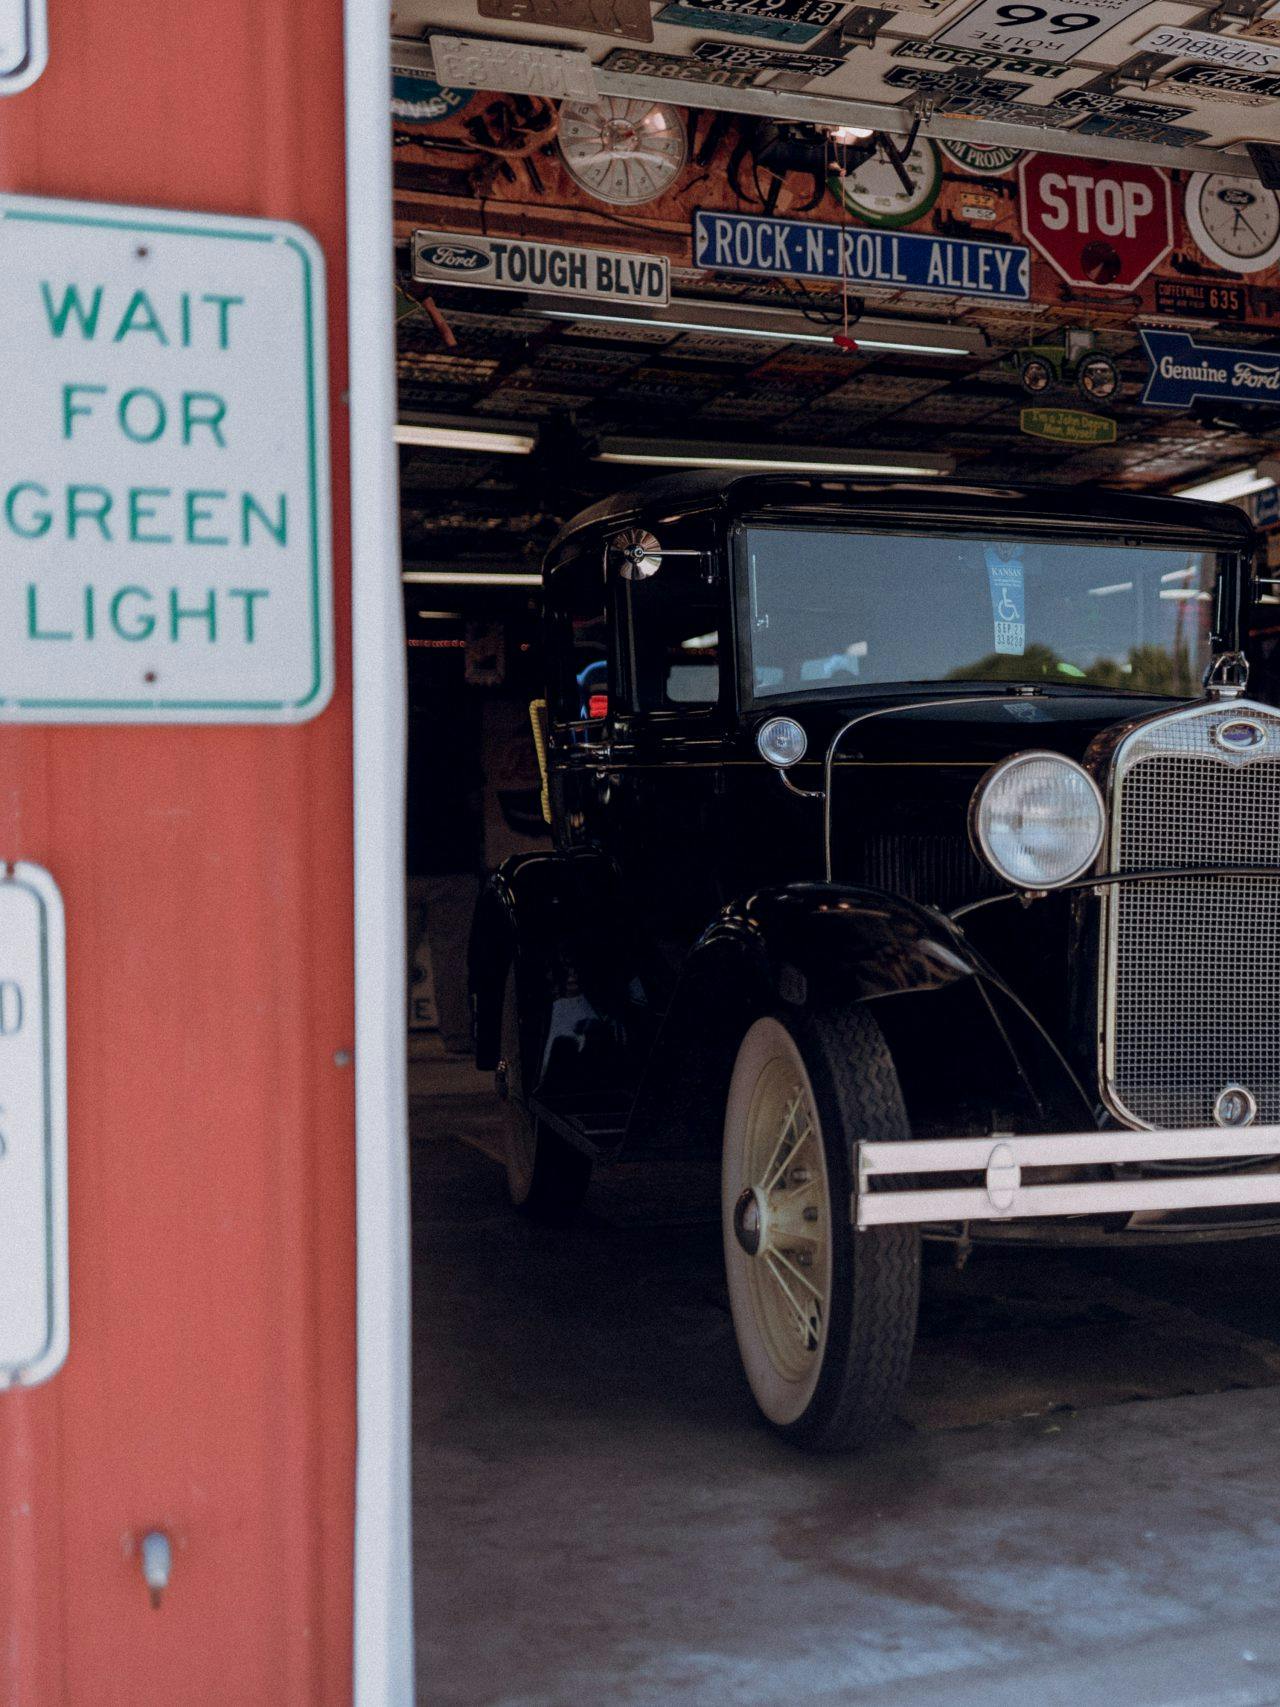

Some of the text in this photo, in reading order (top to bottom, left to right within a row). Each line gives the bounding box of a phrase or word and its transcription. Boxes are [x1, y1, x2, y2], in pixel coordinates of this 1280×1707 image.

[968, 30, 1065, 51] ROUTE
[993, 4, 1101, 35] 66
[981, 42, 1034, 56] US
[1150, 32, 1279, 68] SUPRBUG
[1038, 173, 1156, 239] STOP
[432, 243, 665, 298] Ford TOUGH BLVD
[715, 219, 1014, 293] ROCK-N-ROLL ALLEY
[41, 280, 245, 350] WAIT
[1209, 288, 1240, 312] 635
[1159, 355, 1228, 384] Genuine
[62, 383, 228, 448] FOR
[4, 481, 289, 548] GREEN
[27, 583, 271, 645] LIGHT
